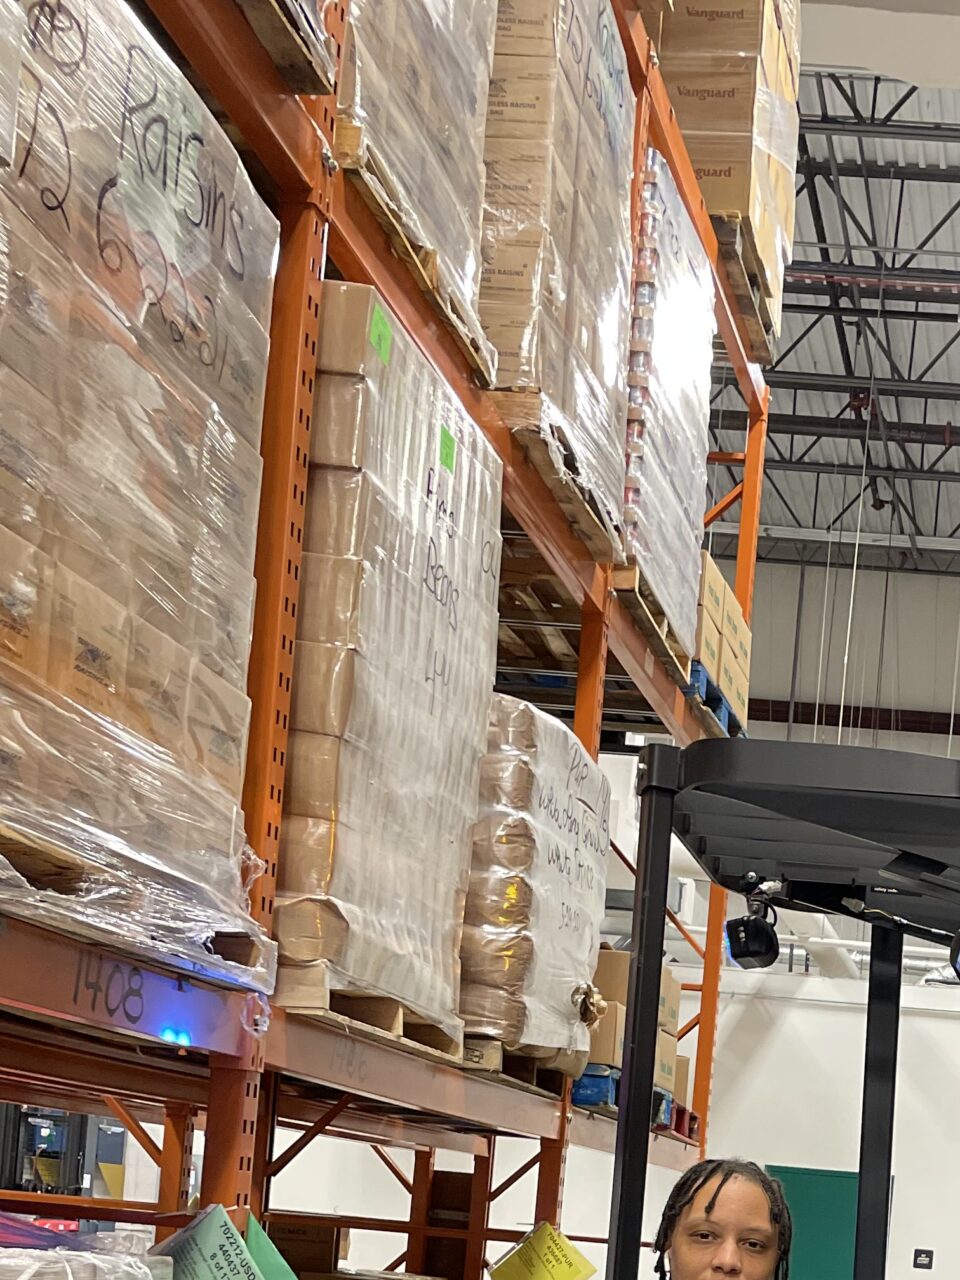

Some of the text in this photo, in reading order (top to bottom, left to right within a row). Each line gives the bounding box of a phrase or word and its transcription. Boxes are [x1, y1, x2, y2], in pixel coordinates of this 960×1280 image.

[686, 6, 744, 21] Vanguard
[677, 85, 736, 100] Vanguard
[120, 45, 244, 282] Raisins
[695, 166, 732, 180] guard
[73, 950, 145, 1025] 1408
[210, 1252, 216, 1260] 8
[215, 1262, 224, 1273] of
[219, 1244, 241, 1277] 440437
